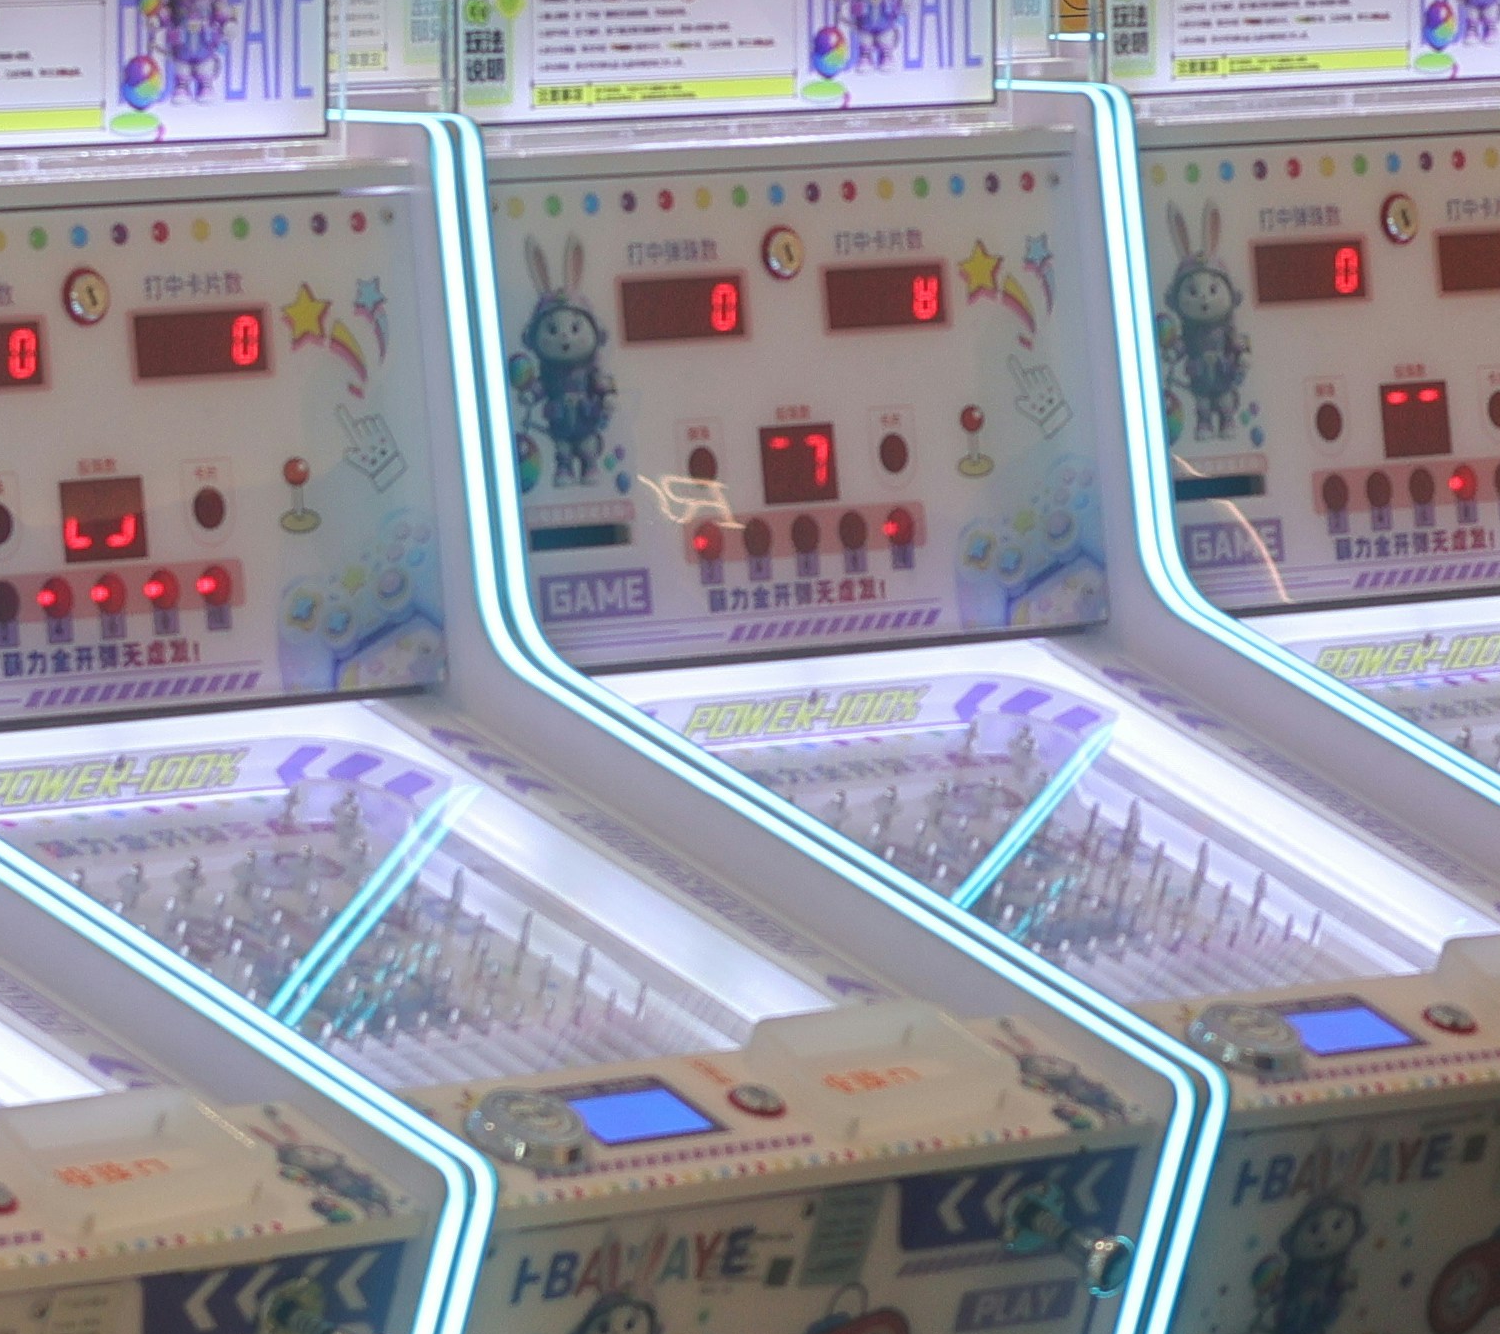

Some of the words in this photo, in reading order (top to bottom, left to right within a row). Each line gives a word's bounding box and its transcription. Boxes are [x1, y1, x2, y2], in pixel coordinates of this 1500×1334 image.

[143, 271, 245, 301] 打中卡片数
[1333, 245, 1361, 295] 0
[709, 281, 739, 332] 0
[7, 326, 38, 380] 0
[230, 313, 259, 367] 0
[1189, 523, 1279, 563] GAME
[546, 576, 649, 616] GAME
[684, 683, 932, 742] POWER-100%
[971, 1285, 1060, 1330] PLAY
